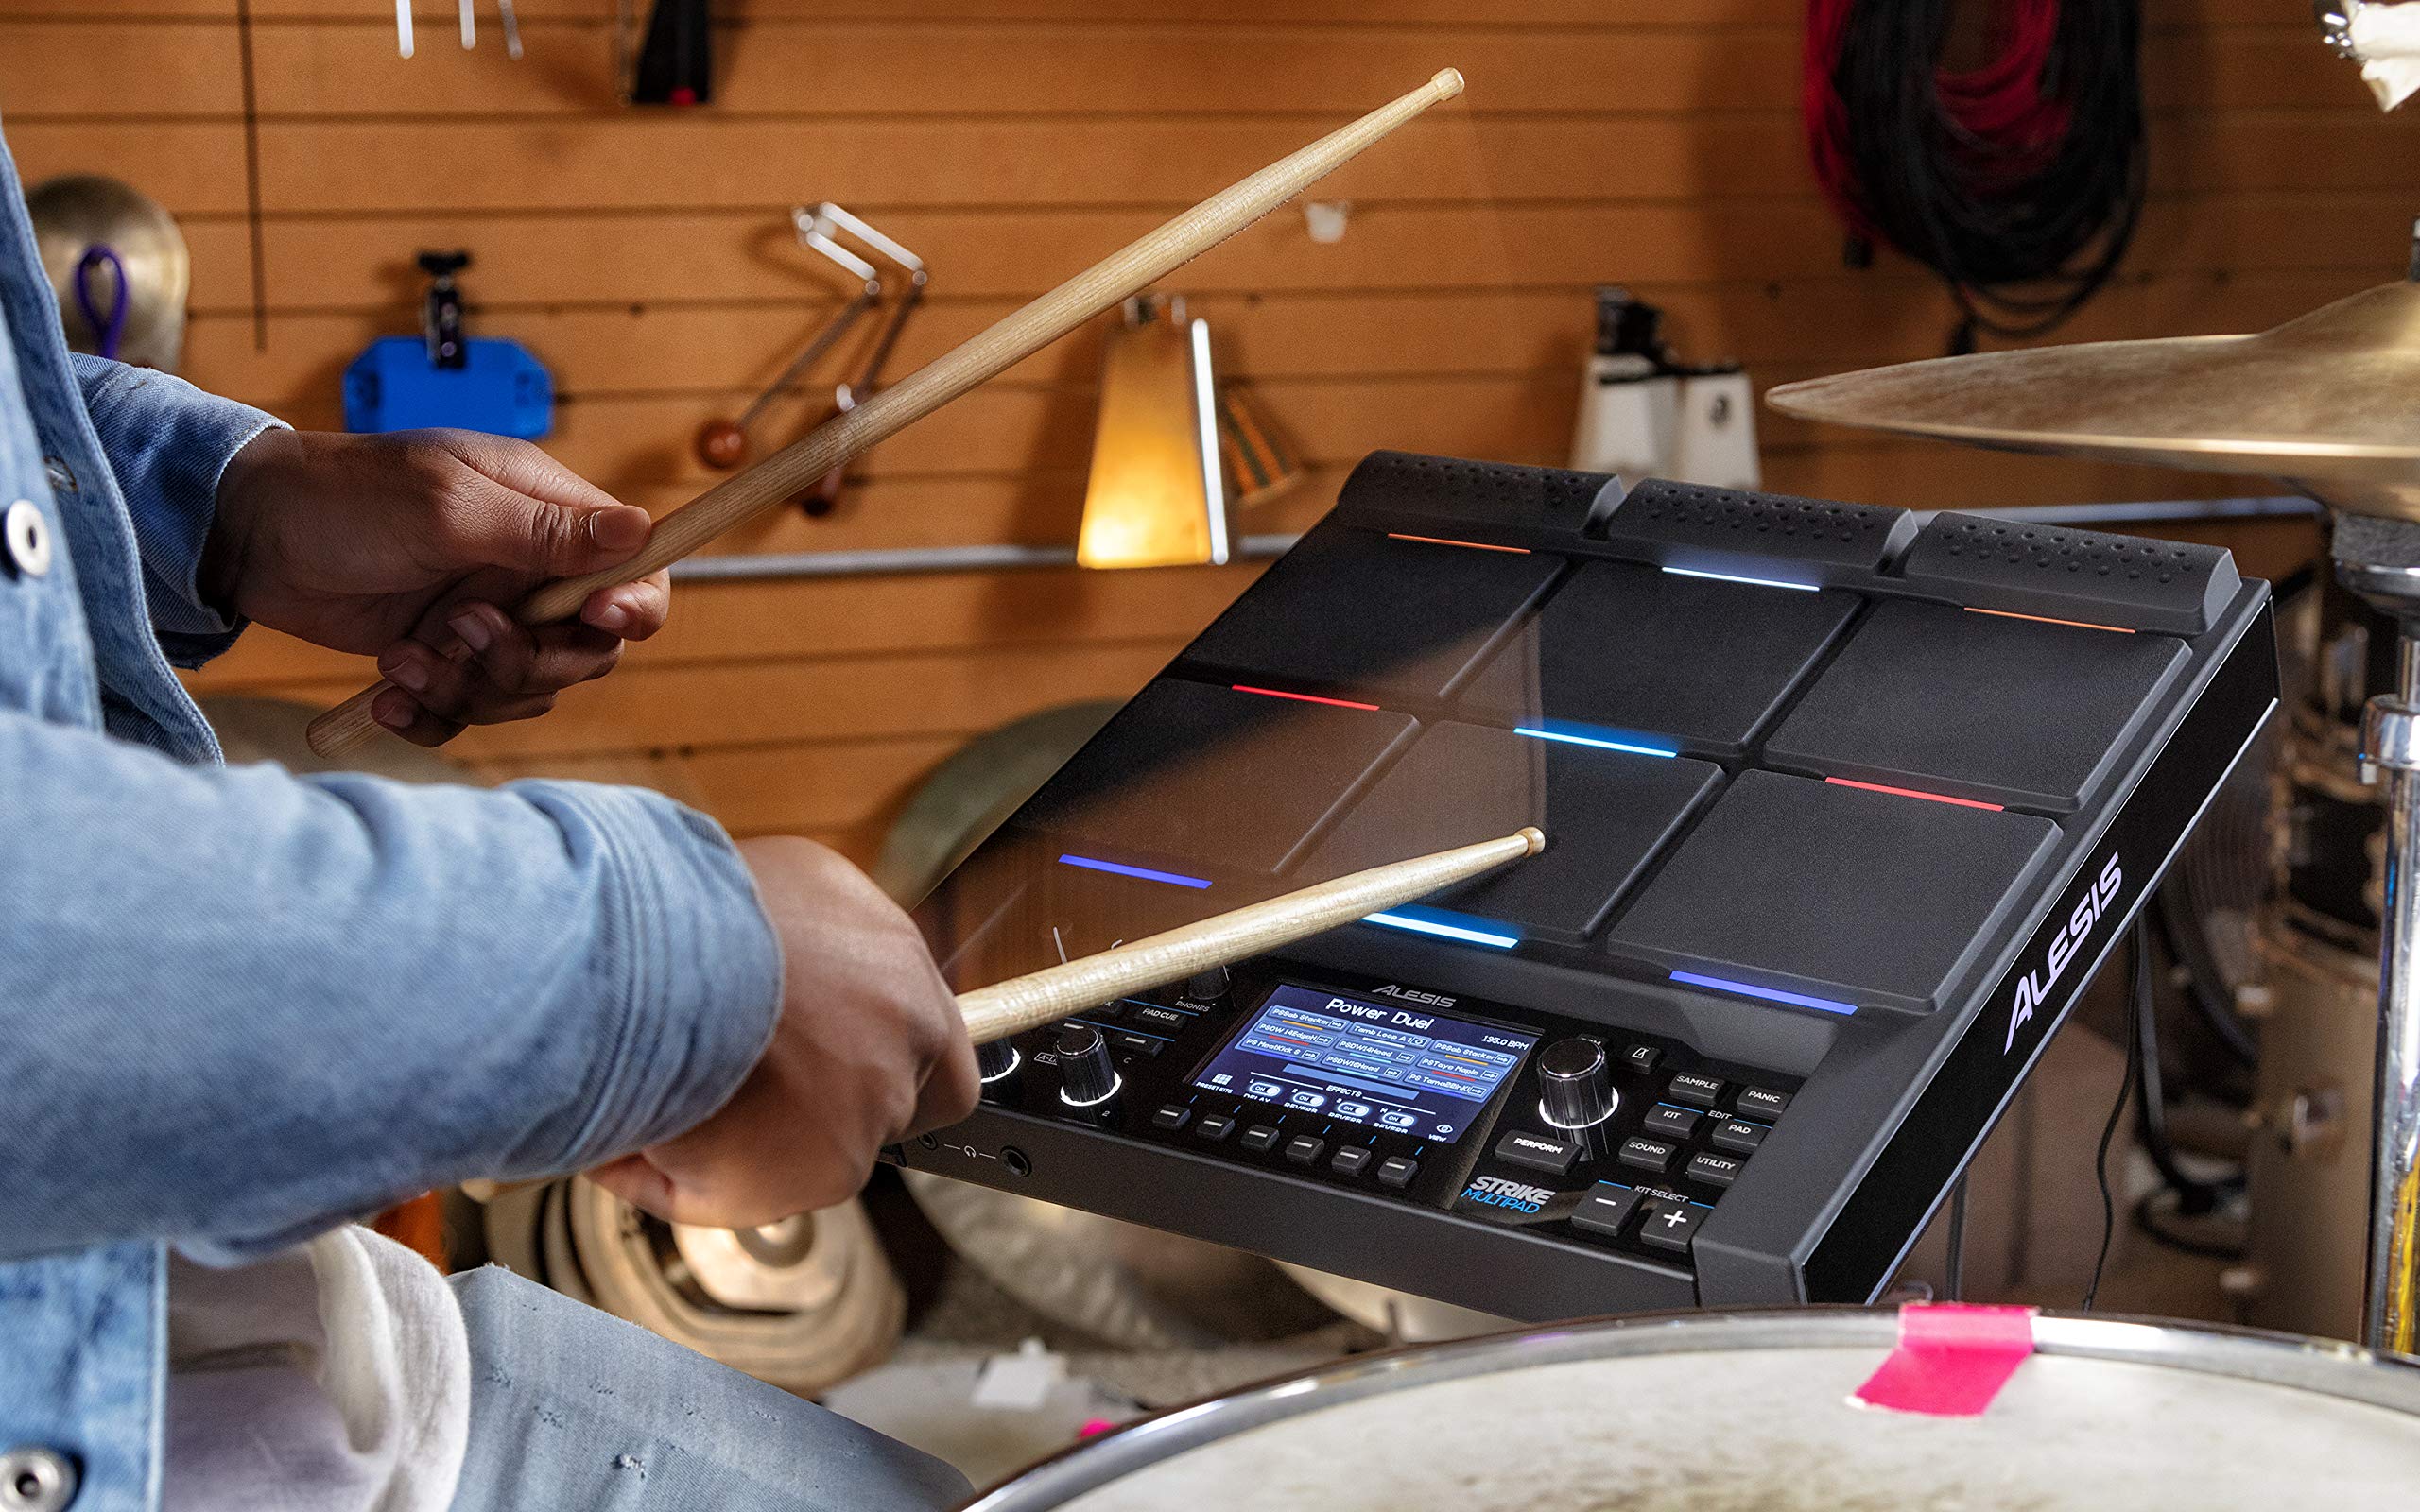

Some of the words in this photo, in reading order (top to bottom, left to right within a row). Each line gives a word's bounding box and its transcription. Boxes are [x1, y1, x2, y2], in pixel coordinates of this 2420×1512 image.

[2004, 850, 2122, 1056] ALESIS
[1372, 985, 1457, 1008] ALESIS
[1175, 1000, 1210, 1012] PHONES
[1142, 1007, 1159, 1017] PAD
[1160, 1011, 1179, 1021] CUE
[1325, 997, 1388, 1021] Power
[1391, 1012, 1435, 1030] Duel
[1355, 1026, 1375, 1036] Tamb
[1376, 1030, 1398, 1040] Loop
[1507, 1040, 1530, 1051] BPM
[1195, 1081, 1219, 1091] PRESET
[1218, 1086, 1233, 1094] KITS
[1676, 1075, 1719, 1090] SAMPLE
[1325, 1085, 1362, 1097] EFFECTS
[1748, 1091, 1781, 1103] PANIC
[1663, 1109, 1682, 1120] KIT
[1707, 1109, 1733, 1120] EDIT
[1728, 1124, 1752, 1134] PAD
[1428, 1133, 1447, 1143] VIEW
[1513, 1137, 1564, 1154] PERFORM
[1628, 1141, 1666, 1155] SOUND
[1696, 1156, 1736, 1170] UTILITY
[1470, 1176, 1557, 1205] STRIKE
[1634, 1185, 1651, 1194] KIT
[1650, 1189, 1689, 1202] SELECT
[1460, 1188, 1541, 1214] MULTIPAD
